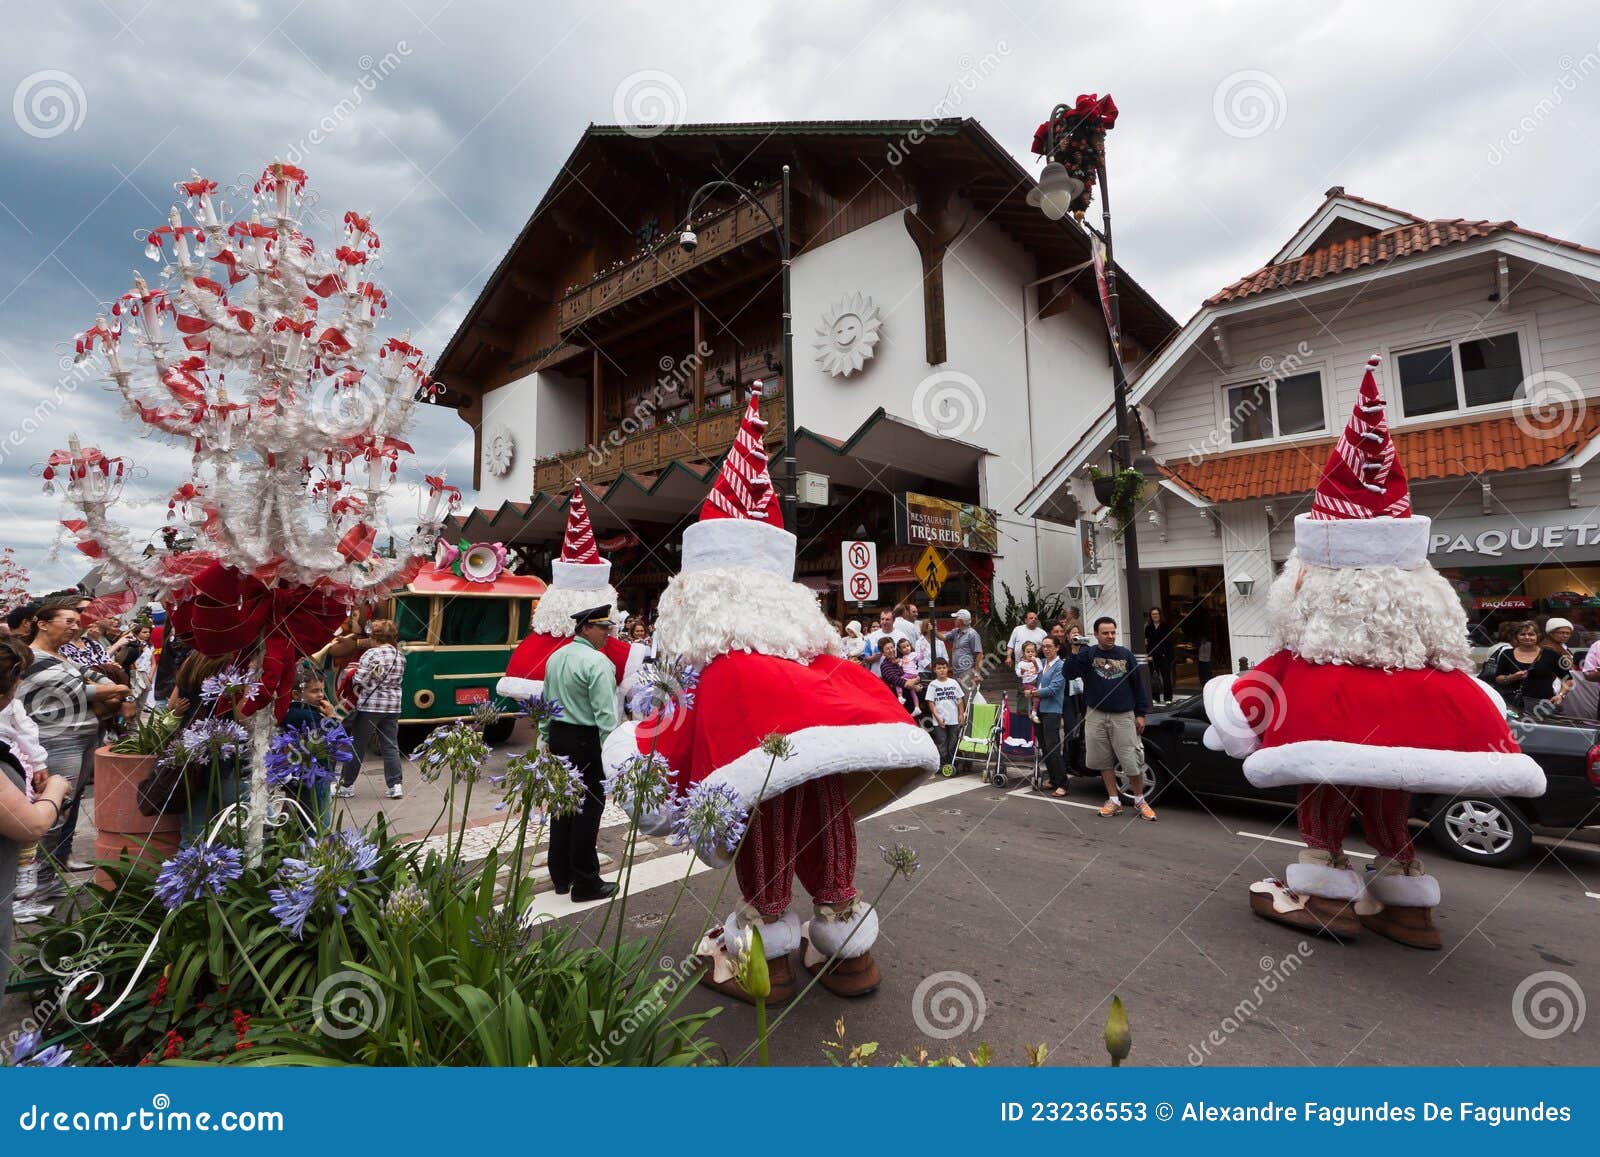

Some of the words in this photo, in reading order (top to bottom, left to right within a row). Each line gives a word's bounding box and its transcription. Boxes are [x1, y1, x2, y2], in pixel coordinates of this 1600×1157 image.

[911, 523, 938, 541] TRÊS
[938, 528, 961, 543] REIS
[1429, 523, 1600, 557] PAQUET
